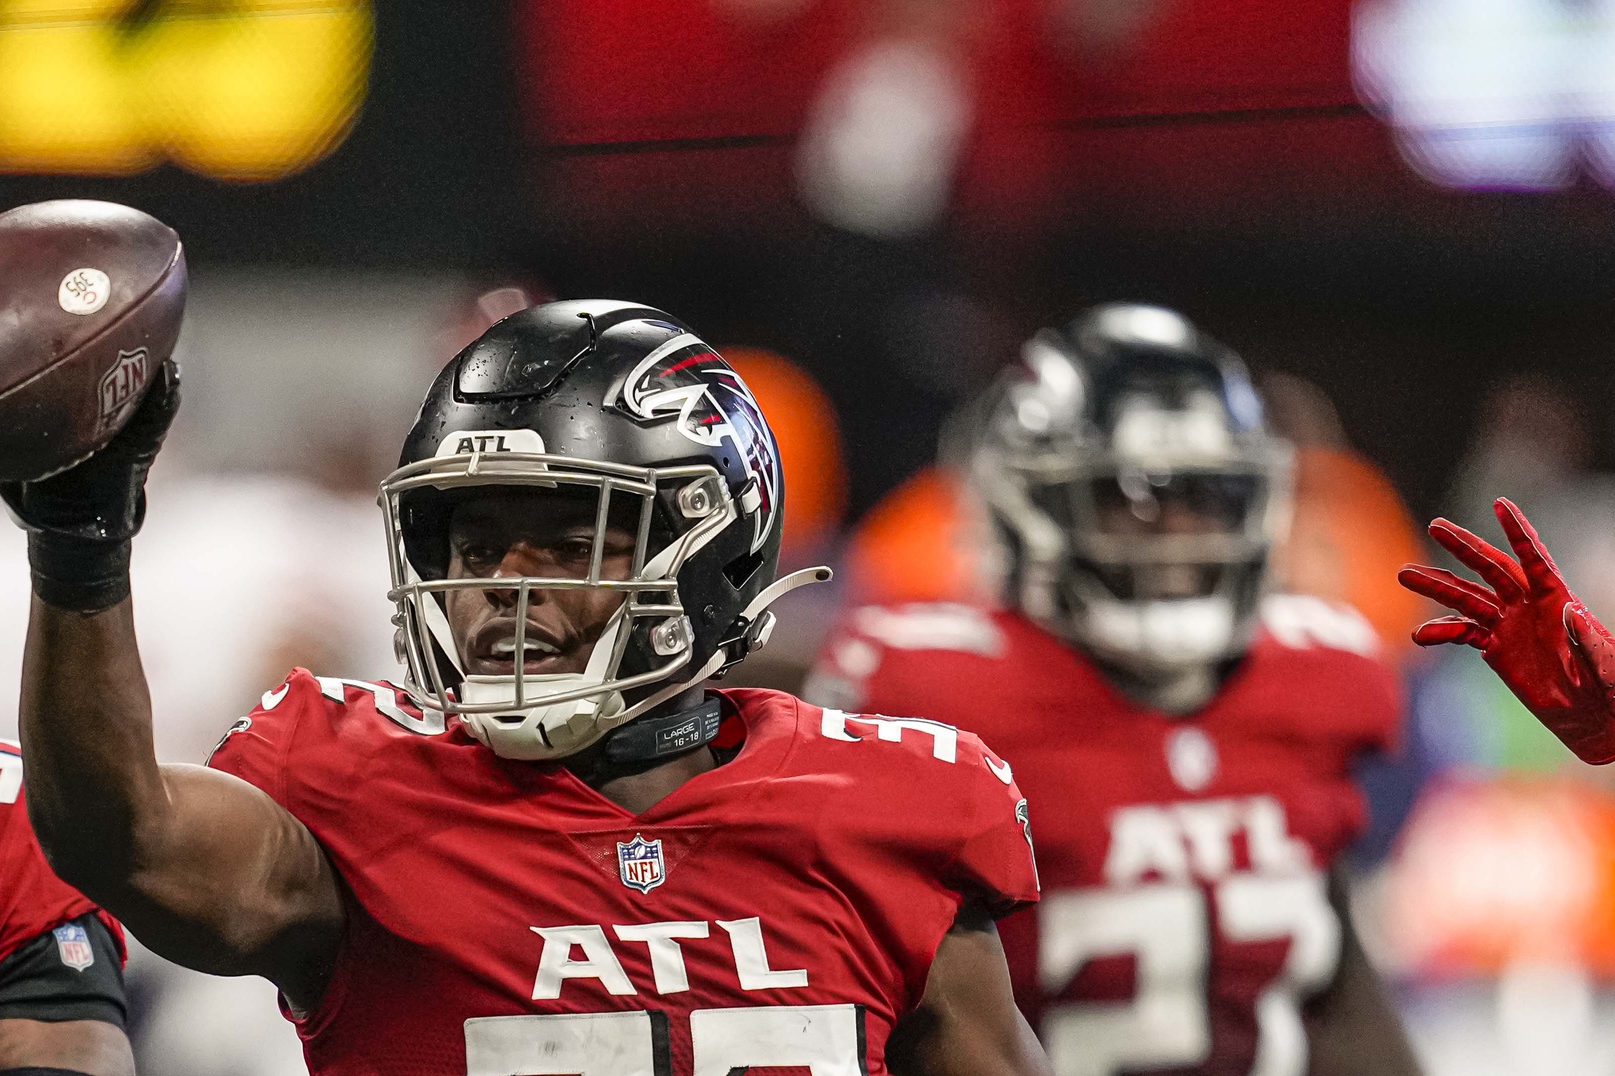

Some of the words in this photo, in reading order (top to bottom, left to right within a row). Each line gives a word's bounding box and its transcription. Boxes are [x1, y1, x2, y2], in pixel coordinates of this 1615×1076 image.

[455, 435, 511, 455] ATL
[663, 722, 695, 740] LARGE
[1103, 795, 1316, 887] ATL
[627, 861, 659, 883] NFL
[530, 917, 809, 1000] ATL
